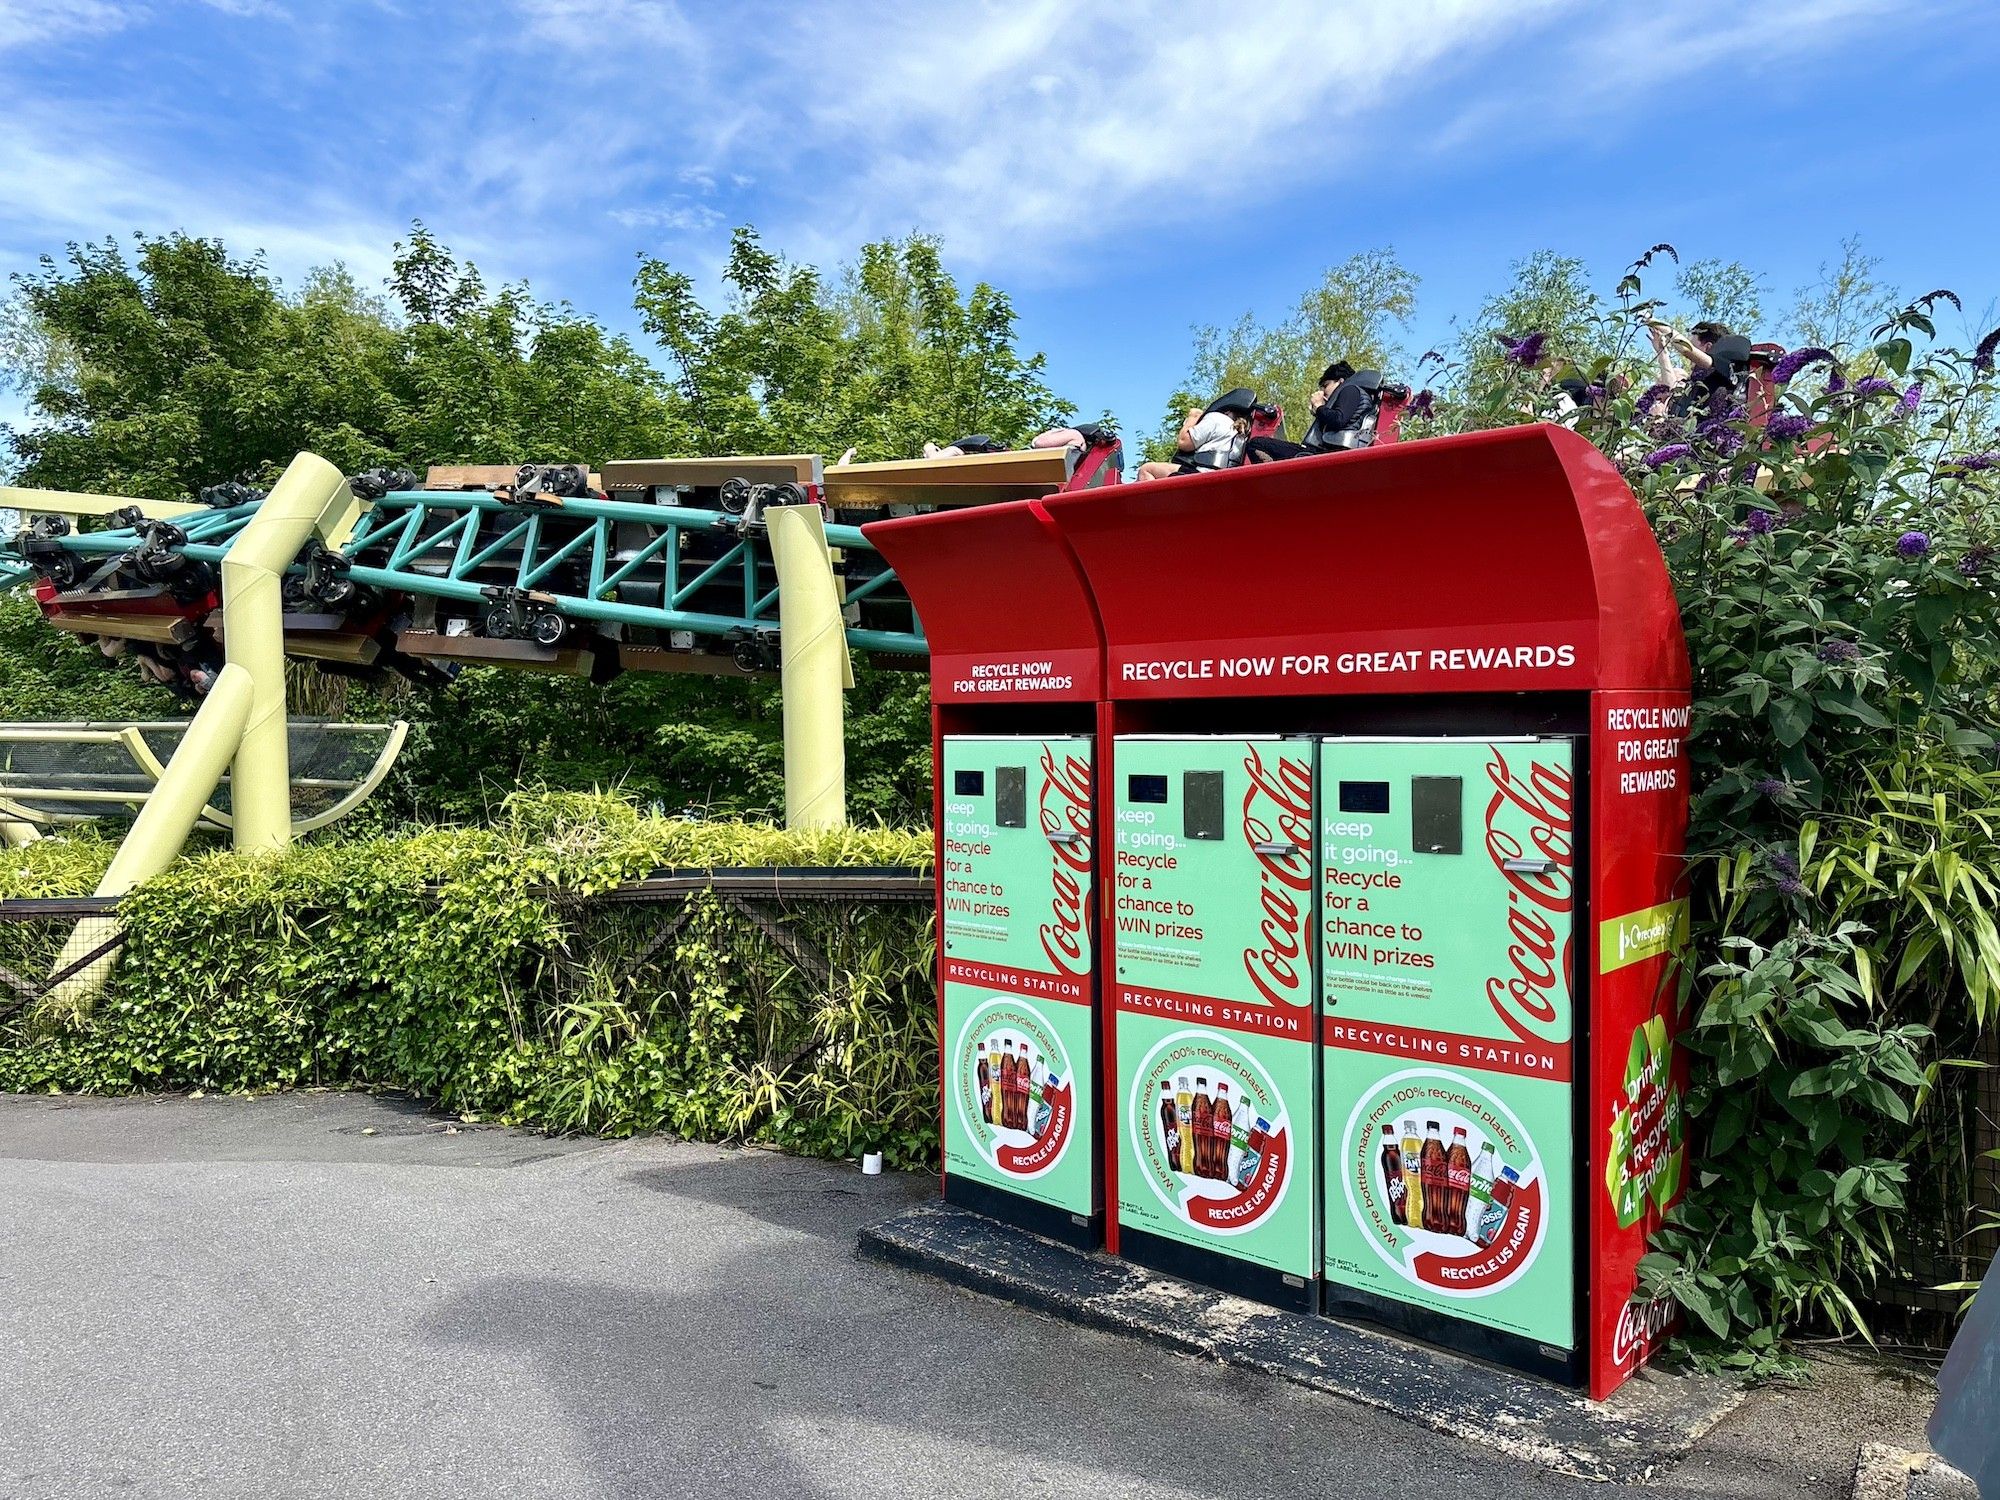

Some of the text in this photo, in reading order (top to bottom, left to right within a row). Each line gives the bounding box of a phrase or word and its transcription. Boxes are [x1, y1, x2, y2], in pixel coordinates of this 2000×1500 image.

[972, 662, 1052, 678] RECYCLE NOW
[1122, 644, 1576, 681] RECYCLE NOW FOR GREAT REWARDS
[953, 676, 1072, 692] FOR GREAT REWARDS
[1608, 706, 1689, 730] RECYCLE NOW
[1618, 738, 1679, 762] FOR GREAT
[1620, 768, 1676, 794] REWARDS
[945, 802, 974, 816] keep
[1117, 807, 1155, 826] keep
[945, 820, 998, 838] it going...
[1117, 829, 1186, 850] it going...
[1325, 818, 1373, 839] keep
[946, 839, 991, 856] Recycle
[1324, 843, 1413, 867] it going...
[946, 858, 972, 873] for a
[1118, 851, 1177, 871] Recycle
[946, 878, 1003, 896] chance to
[1117, 872, 1152, 889] for a
[1325, 867, 1401, 889] Recycle
[946, 897, 1010, 917] WIN prizes
[1118, 895, 1194, 916] chance to
[1325, 892, 1369, 911] for a
[1118, 916, 1203, 940] WIN prizes
[1326, 917, 1422, 941] chance to
[1326, 941, 1435, 968] WIN prizes
[950, 964, 1080, 996] RECYCLING STATION
[984, 1012, 1004, 1025] 100%
[1005, 1012, 1037, 1031] recycled
[1123, 992, 1298, 1031] RECYCLING STATION
[970, 1024, 985, 1042] from
[963, 1042, 973, 1070] made
[1170, 1046, 1195, 1062] 100%
[1197, 1048, 1240, 1071] recycled
[1334, 1026, 1554, 1070] RECYCLING STATION
[1151, 1058, 1171, 1079] from
[962, 1072, 974, 1111] bottles
[1393, 1086, 1425, 1104] 100%
[1612, 1047, 1662, 1120] 1. Drink!
[1142, 1080, 1155, 1112] made
[1428, 1088, 1482, 1114] recycled
[1369, 1099, 1394, 1123] from
[1616, 1076, 1667, 1153] 2. Crush!
[1012, 1105, 1066, 1166] RECYCLE US AGAIN
[1141, 1113, 1155, 1157] bottles
[1358, 1124, 1374, 1158] made
[1620, 1093, 1679, 1187] 3. Recycle!
[1152, 1157, 1175, 1192] We're
[1208, 1153, 1280, 1220] RECYCLE US AGAIN
[1357, 1161, 1374, 1209] bottles
[1623, 1138, 1672, 1215] 4. Enjoy!
[1371, 1210, 1398, 1248] We're
[1481, 1210, 1503, 1226] asis
[1441, 1206, 1531, 1280] RECYCLE US AGAIN
